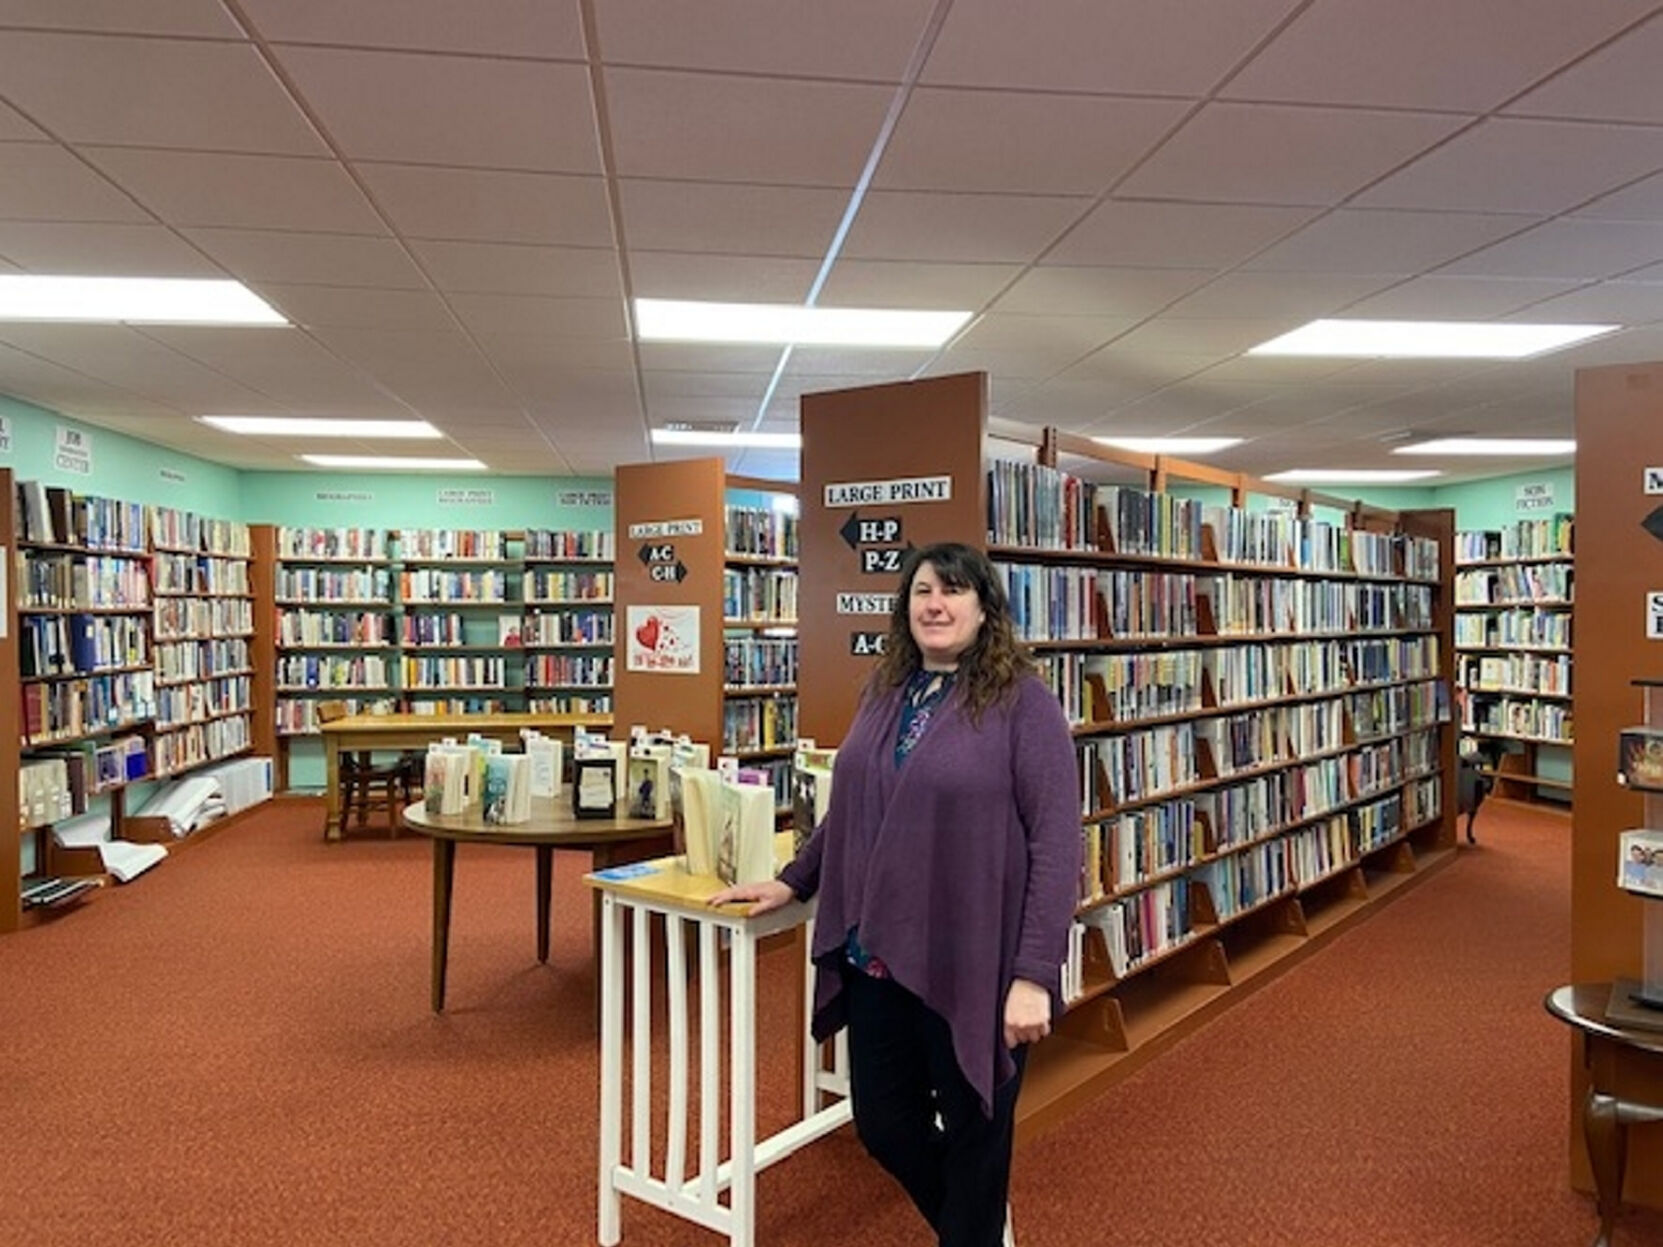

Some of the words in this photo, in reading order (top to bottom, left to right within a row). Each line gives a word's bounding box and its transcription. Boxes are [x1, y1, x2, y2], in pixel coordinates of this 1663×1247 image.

[829, 484, 882, 504] LARGE
[890, 480, 947, 500] PRINT
[631, 524, 663, 537] LARGE
[667, 521, 700, 536] PRINT
[859, 520, 899, 542] H-P
[865, 550, 900, 571] P-Z
[840, 595, 899, 612] MYSTE
